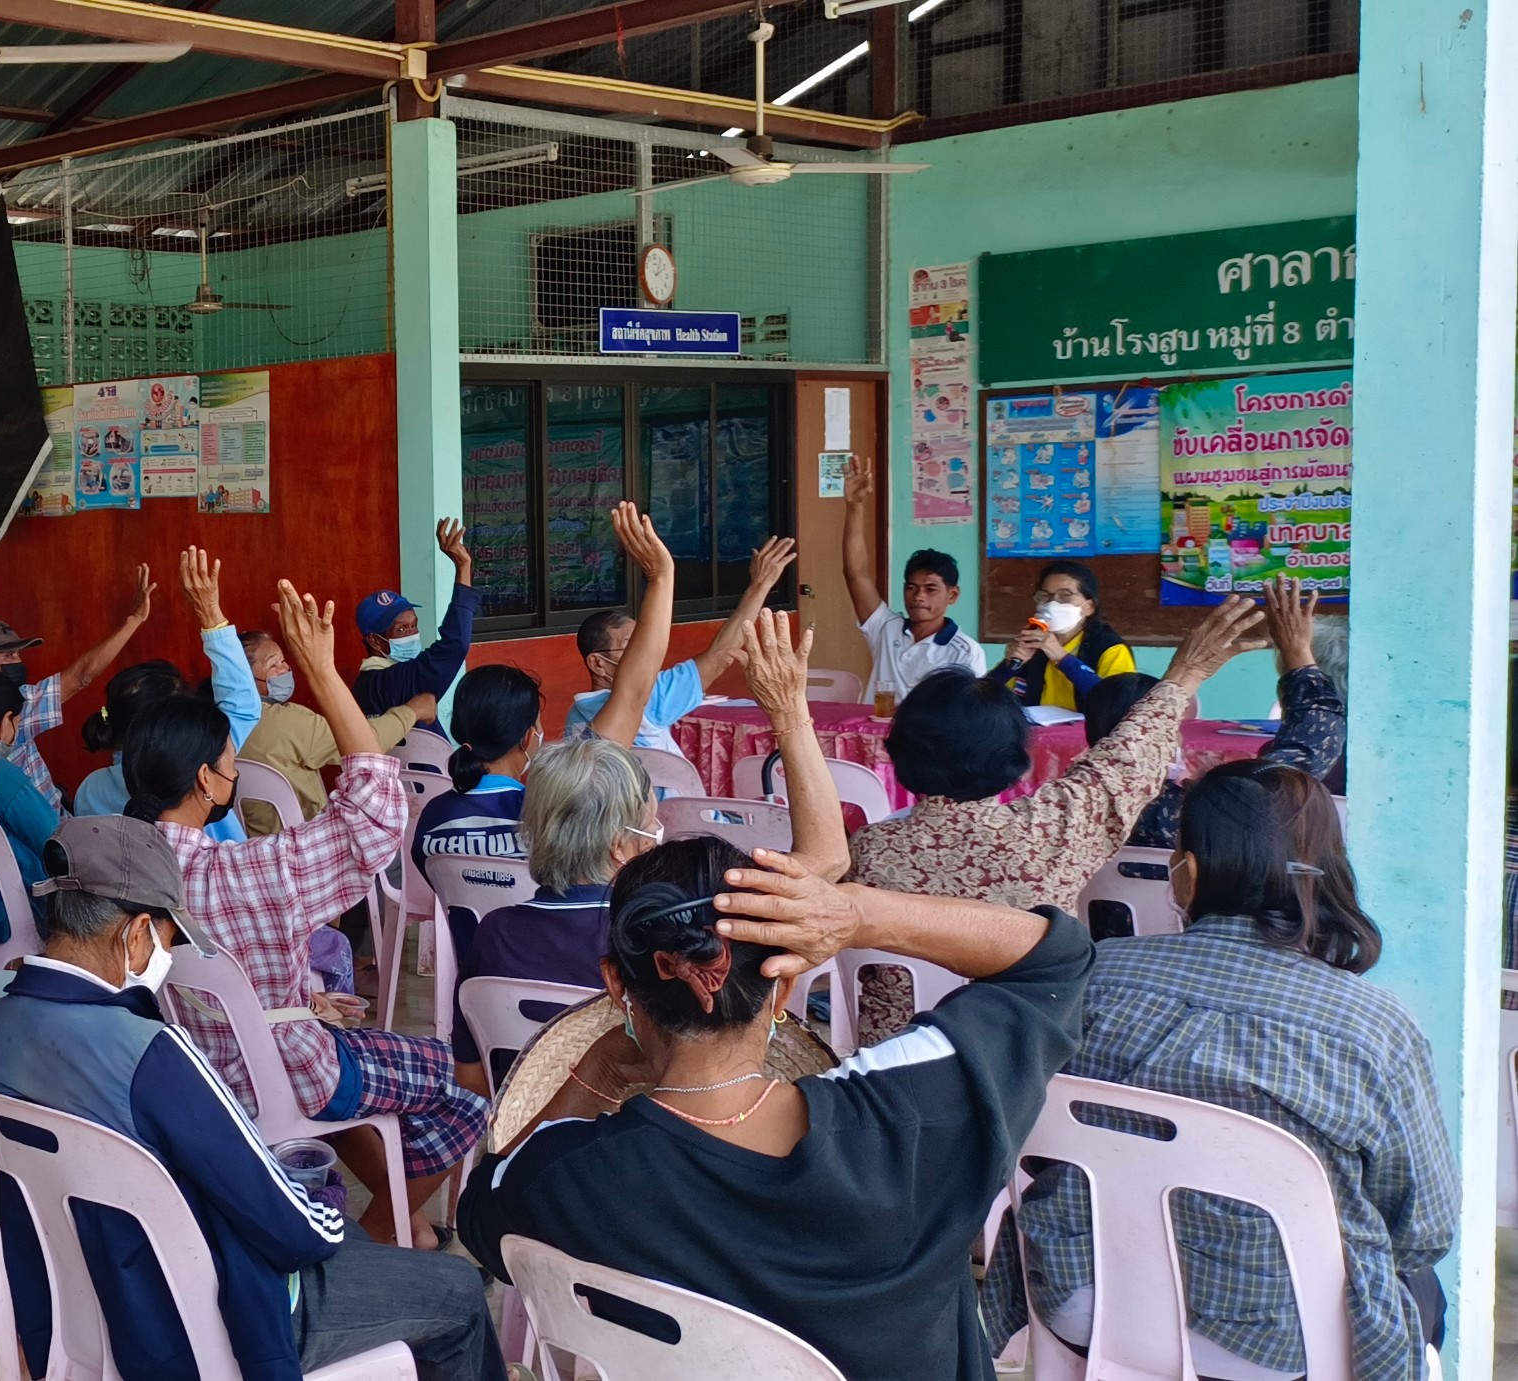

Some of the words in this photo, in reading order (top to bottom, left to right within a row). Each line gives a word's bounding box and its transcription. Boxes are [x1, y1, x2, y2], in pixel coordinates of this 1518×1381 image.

[676, 327, 700, 342] Health
[701, 328, 728, 342] Station
[1052, 318, 1199, 366] บ้านโรงสูบ
[1206, 301, 1275, 361] หมู่ที่
[1283, 322, 1301, 345] 8
[98, 386, 105, 397] 4
[1206, 575, 1231, 591] วันที่
